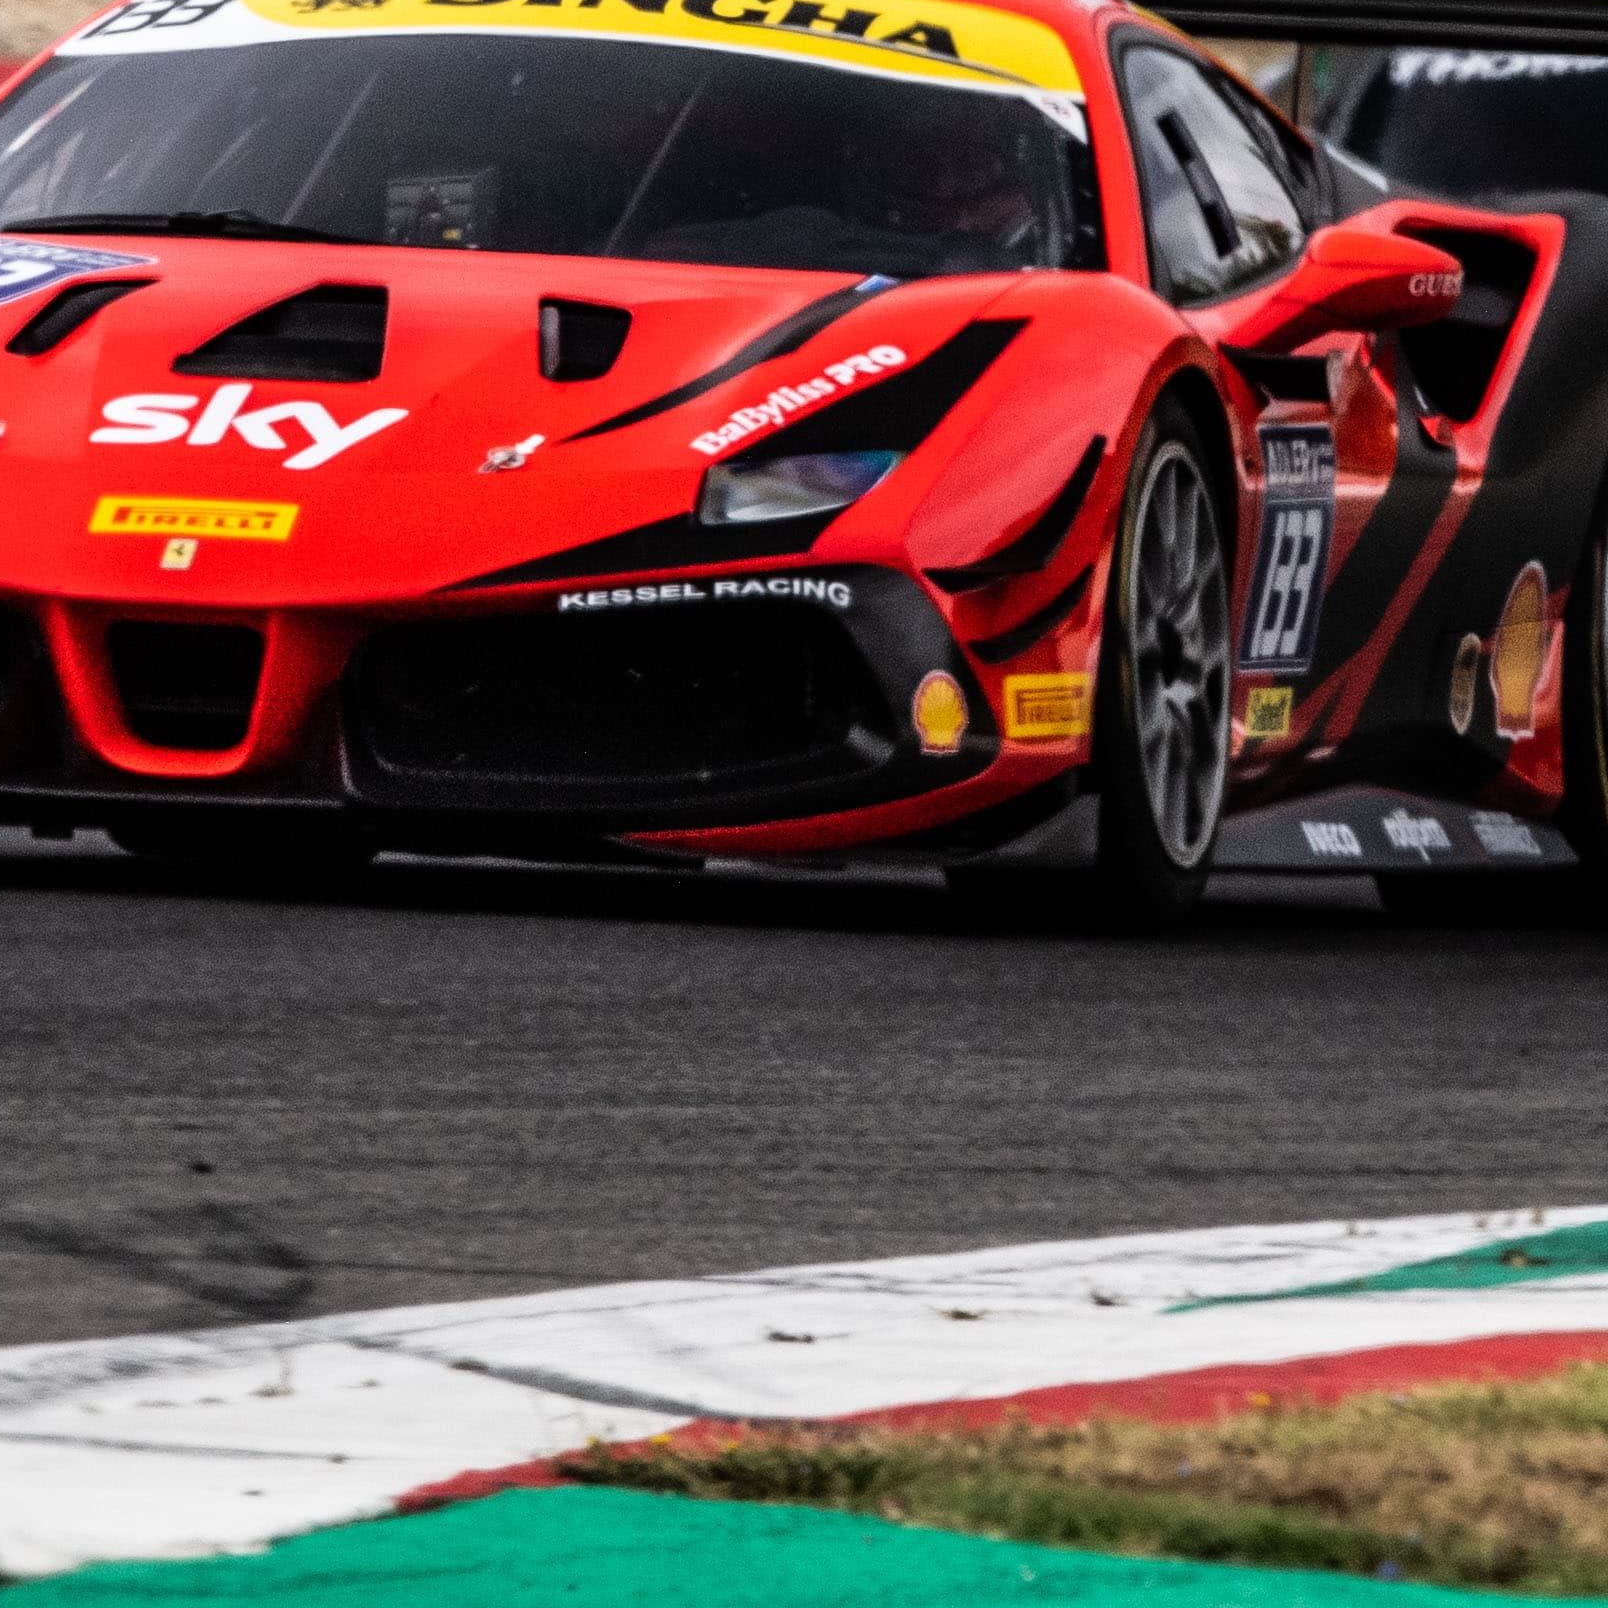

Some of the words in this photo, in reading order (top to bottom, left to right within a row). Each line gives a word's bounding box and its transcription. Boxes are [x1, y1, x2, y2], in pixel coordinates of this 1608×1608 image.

[824, 345, 907, 385] PRO
[89, 383, 410, 470] sky
[112, 506, 279, 530] PIRELLI
[558, 583, 706, 611] KESSEL
[713, 577, 852, 608] RACING
[1249, 509, 1324, 659] 133
